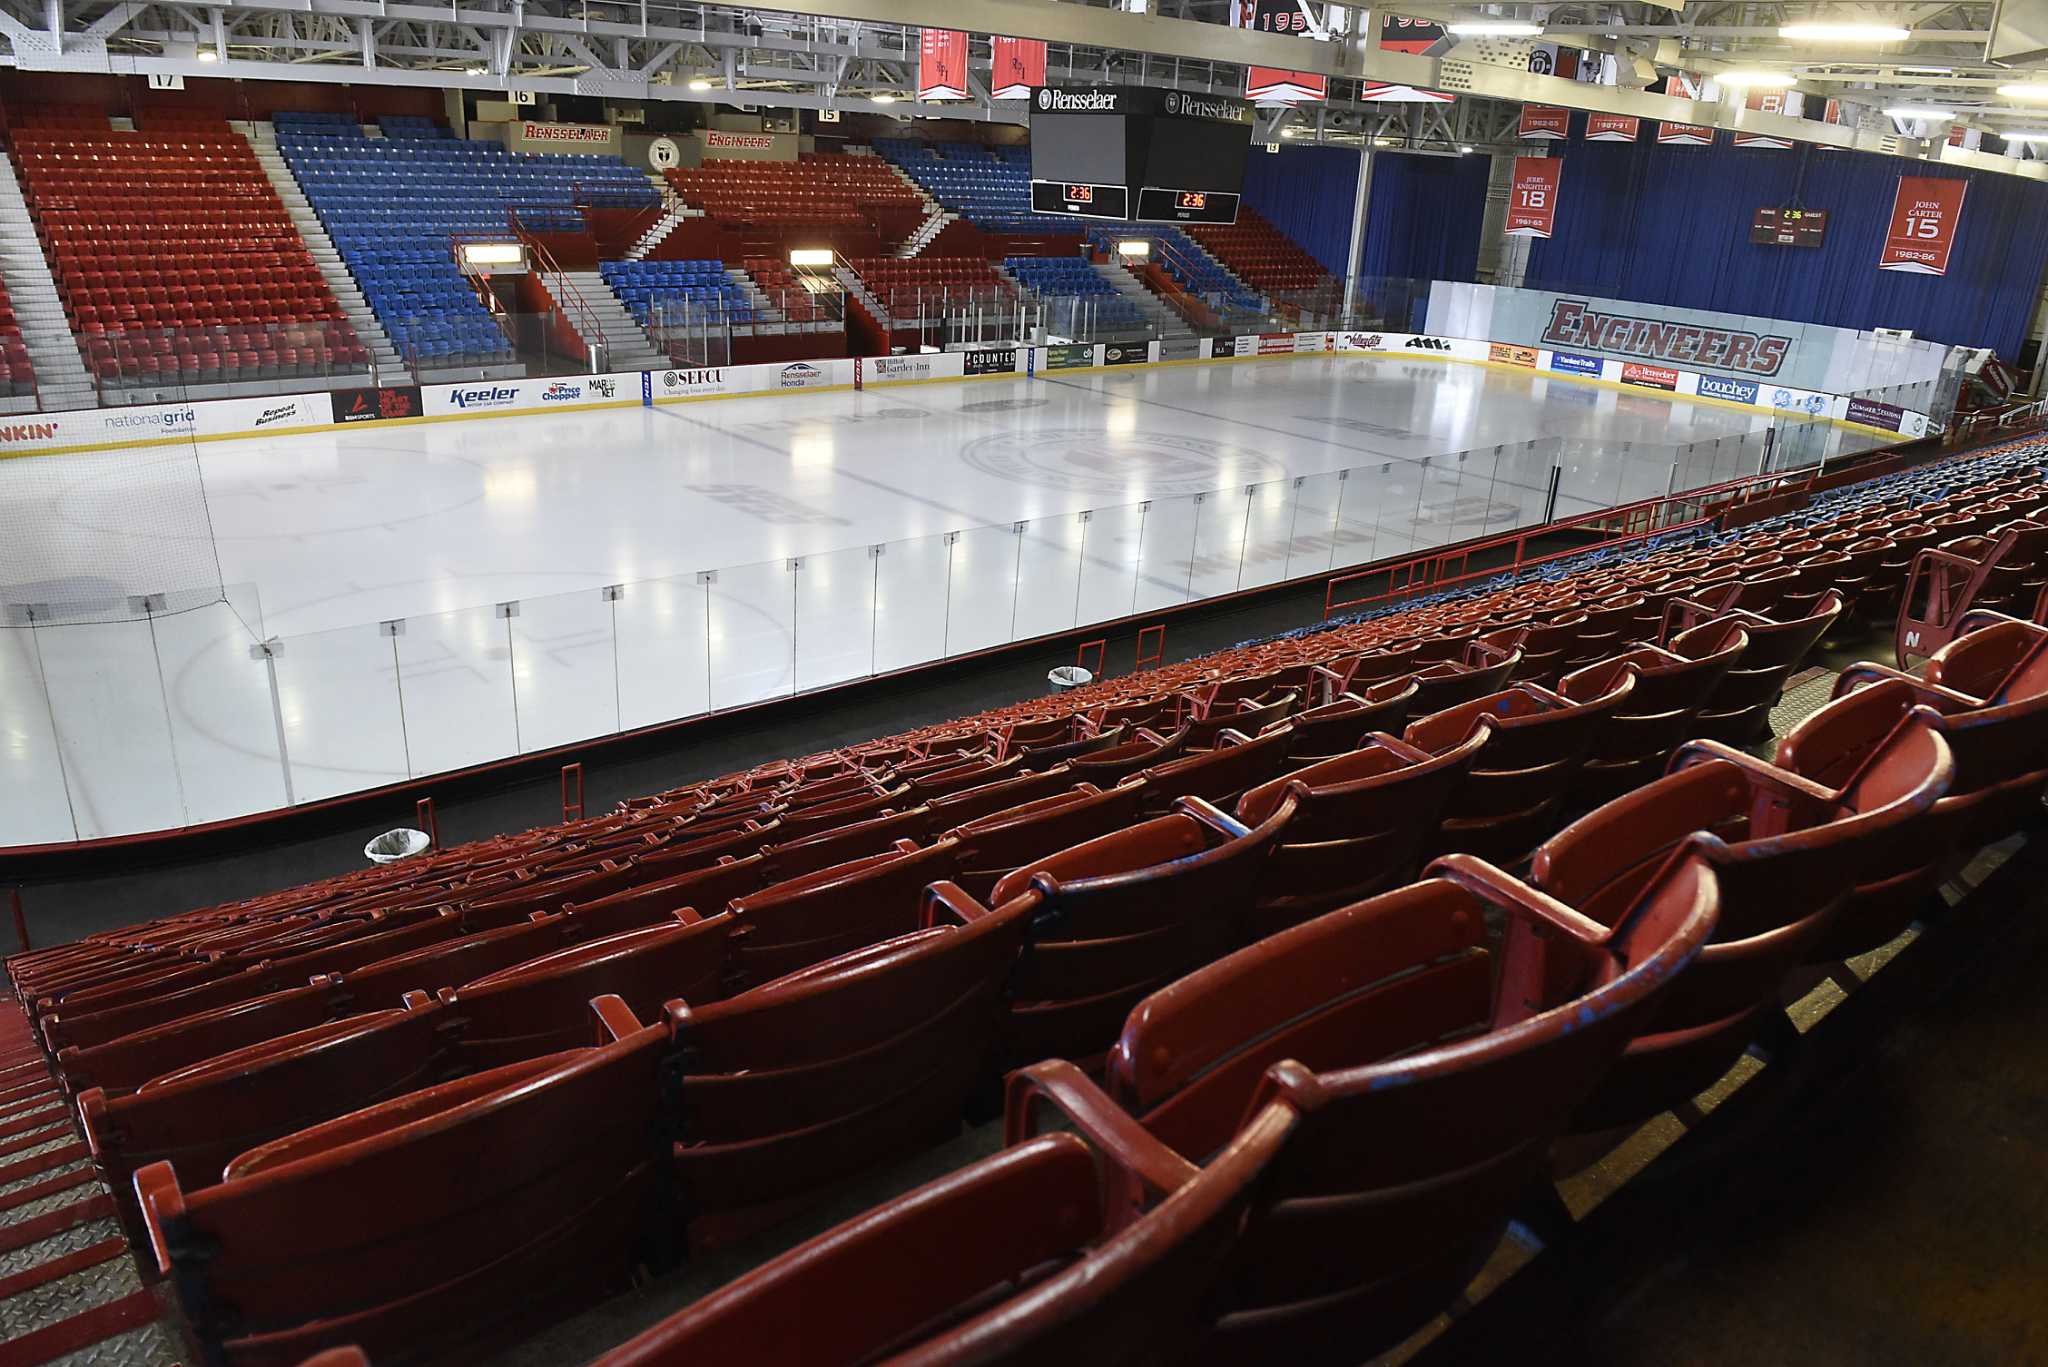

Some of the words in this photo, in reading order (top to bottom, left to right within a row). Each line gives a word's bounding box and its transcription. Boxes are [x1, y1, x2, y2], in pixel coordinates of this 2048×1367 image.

[1262, 12, 1307, 32] 195
[514, 91, 528, 103] 16
[1051, 89, 1117, 110] Rensselaer
[823, 108, 835, 120] 15
[1180, 94, 1246, 121] Rensselaer
[525, 125, 609, 141] RENSSELAER
[708, 133, 772, 148] ENGINEERS
[1070, 185, 1090, 200] 2:36
[1182, 193, 1204, 207] 2:36
[1520, 190, 1546, 208] 18
[1914, 201, 1940, 209] JOHN
[1908, 209, 1942, 219] CARTER
[1905, 217, 1939, 239] 15
[1895, 250, 1936, 261] 1982-86
[1541, 298, 1793, 377] ENGINEERS
[972, 352, 1016, 364] COUNTER
[916, 363, 930, 371] Inn
[678, 369, 725, 386] SEFCU
[781, 371, 822, 379] Rensselaer
[558, 386, 581, 394] Price
[781, 379, 805, 388] Honda
[1701, 376, 1756, 400] bouchey
[450, 387, 520, 408] Keeler
[542, 392, 581, 401] Chopper
[255, 409, 297, 426] Business
[262, 403, 296, 418] Repeat
[105, 409, 195, 428] nationalgrid
[1905, 631, 1920, 648] N
